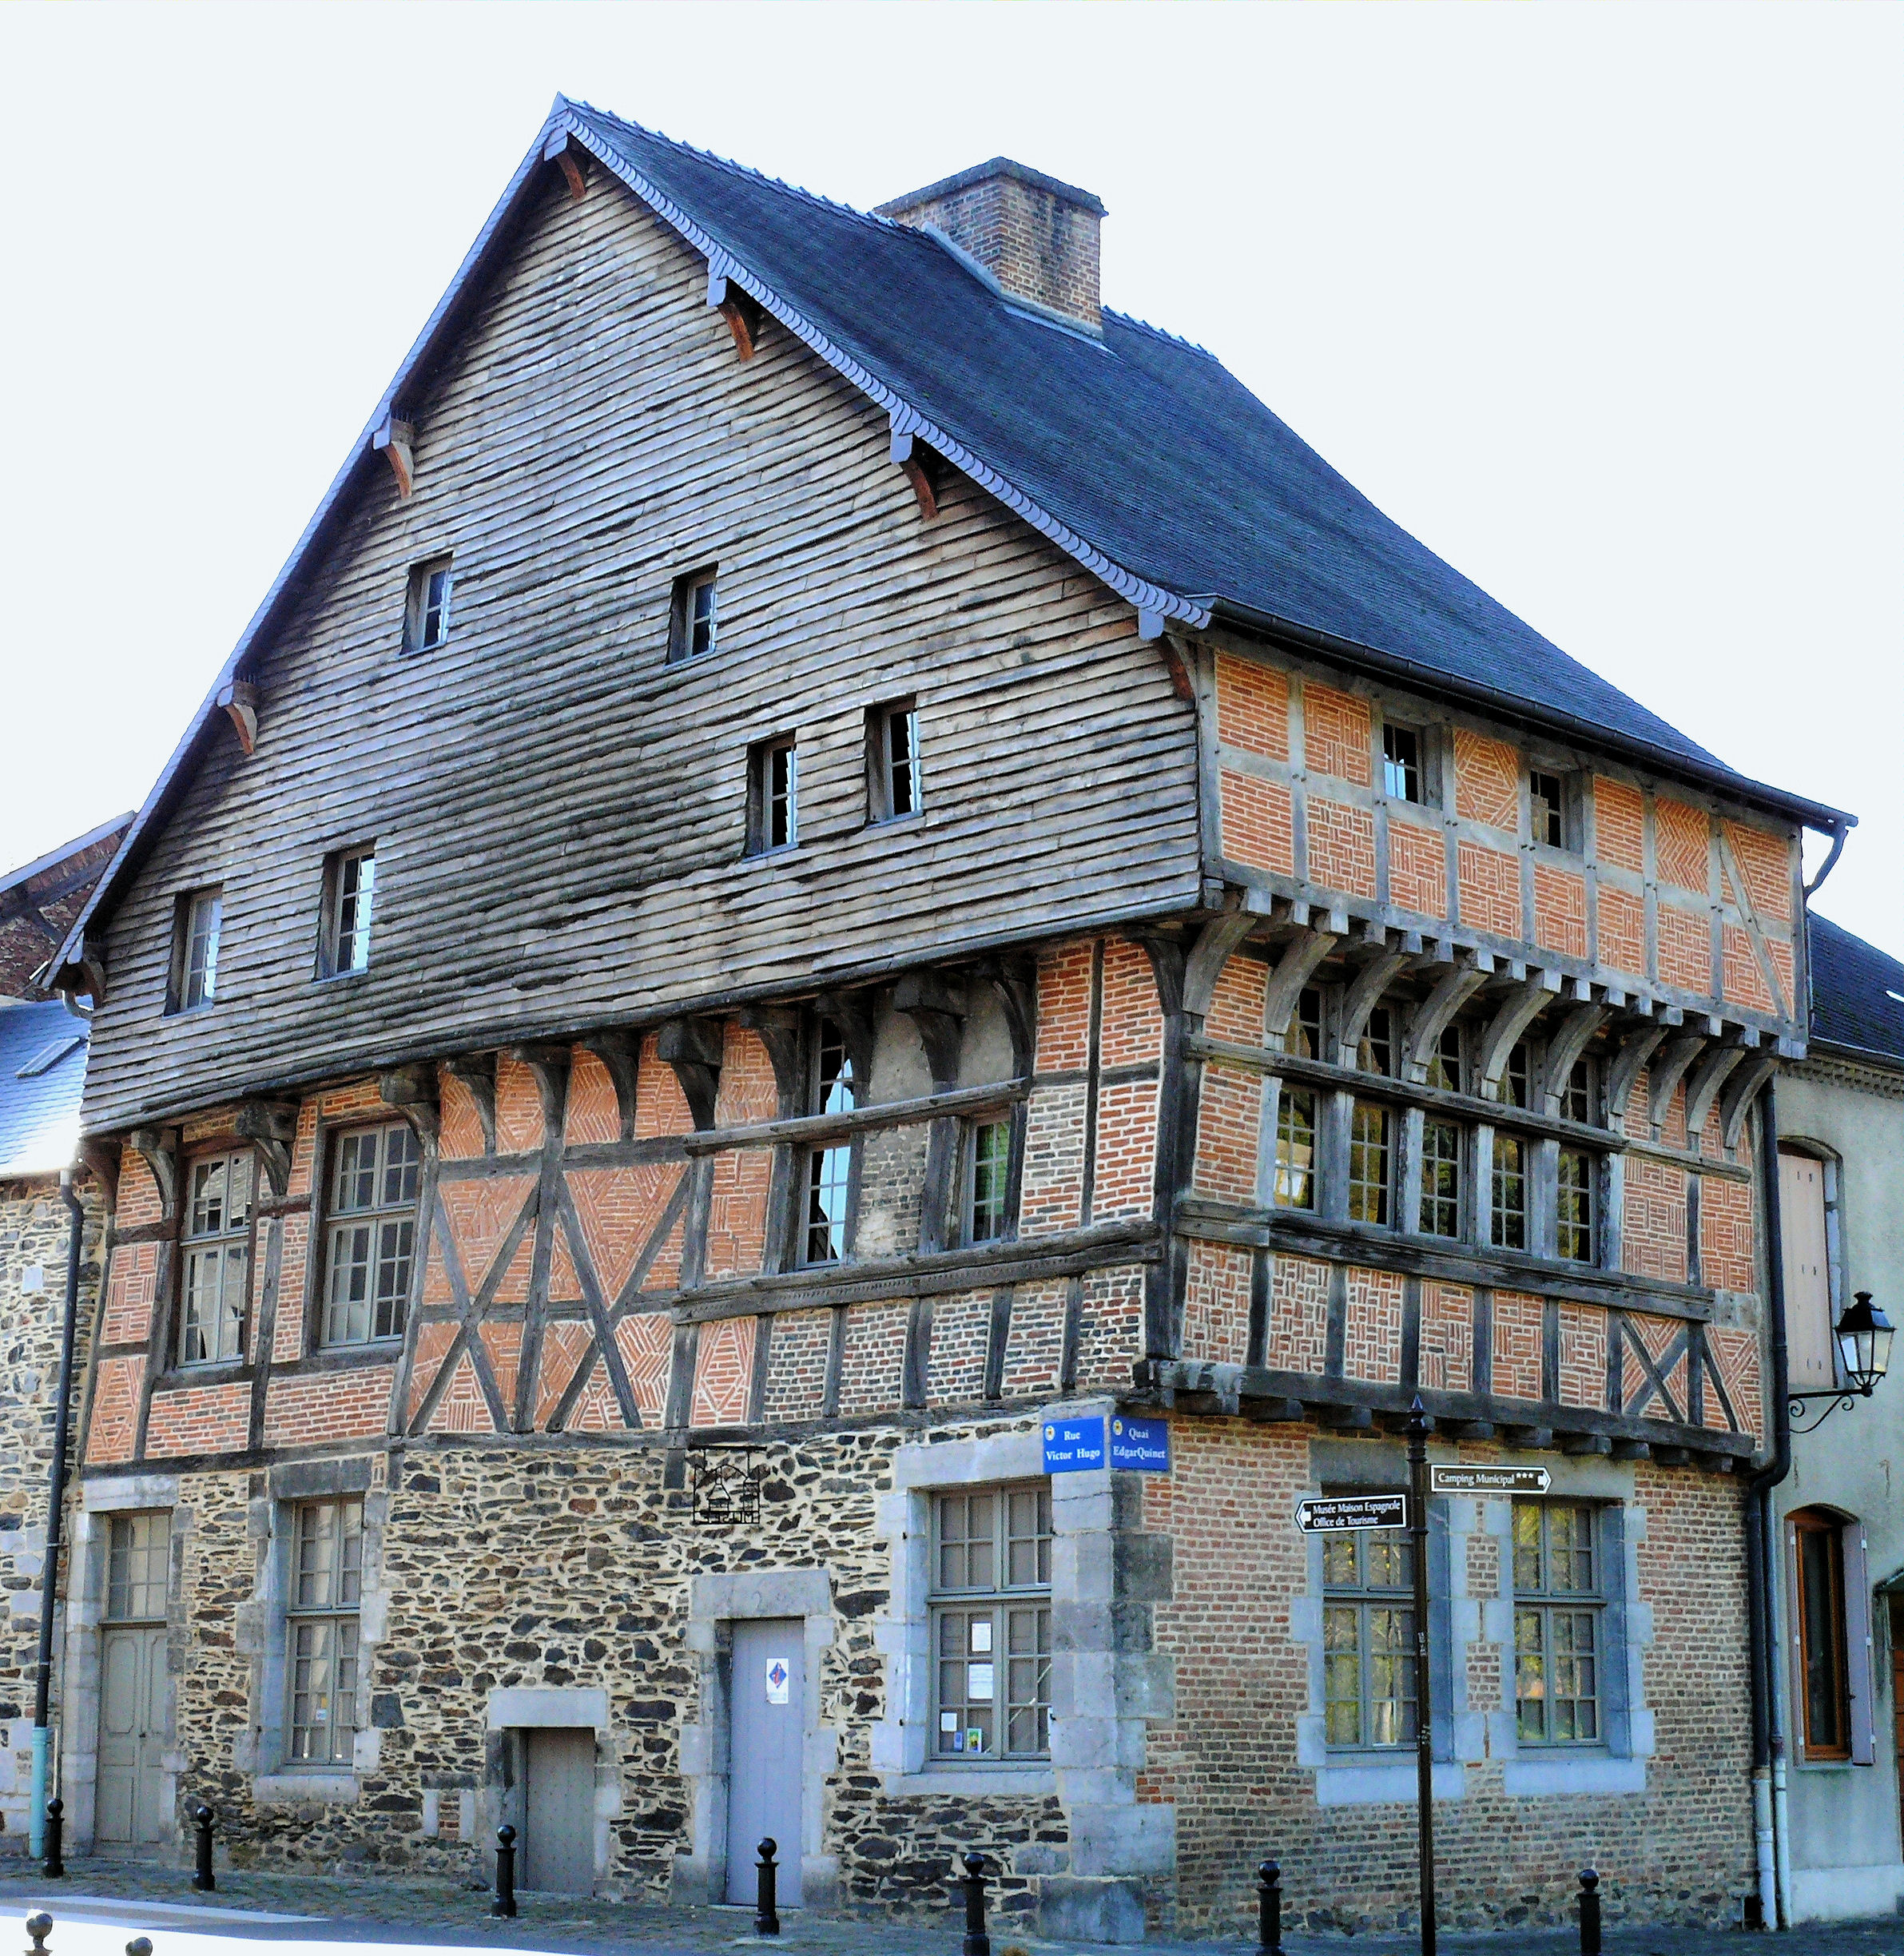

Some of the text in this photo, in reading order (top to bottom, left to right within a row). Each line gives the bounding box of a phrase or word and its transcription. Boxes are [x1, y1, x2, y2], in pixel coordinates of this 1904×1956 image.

[1063, 1430, 1080, 1441] Rue
[1128, 1427, 1149, 1441] Quai
[1046, 1448, 1100, 1461] Victor Hugo
[1438, 1473, 1514, 1487] Camping Municipal
[1313, 1500, 1401, 1514] Musée Maison Espagnole
[1313, 1516, 1378, 1527] Office de Tourisme
